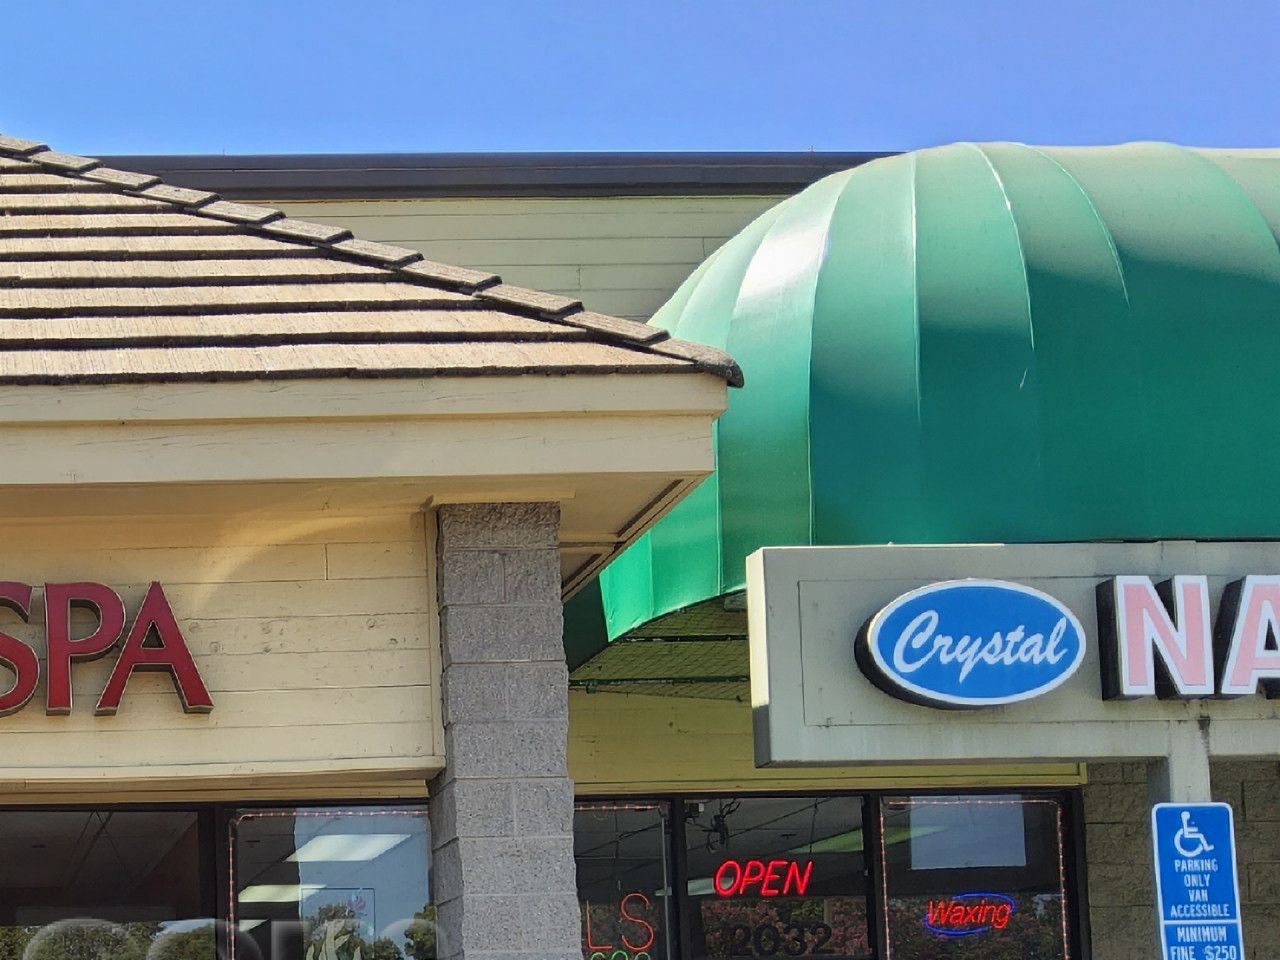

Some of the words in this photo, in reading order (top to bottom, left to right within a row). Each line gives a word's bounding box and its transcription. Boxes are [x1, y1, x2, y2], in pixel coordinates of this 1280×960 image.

[892, 609, 1069, 685] Crystal
[1174, 858, 1219, 873] PARKING
[714, 858, 813, 897] OPEN
[1184, 874, 1210, 888] ONLY
[1188, 889, 1209, 903] VAN
[927, 899, 1012, 929] Waxing
[1170, 903, 1231, 918] ACCESSIBLE
[1177, 926, 1227, 943] MINIMUM
[1204, 945, 1237, 960] $250
